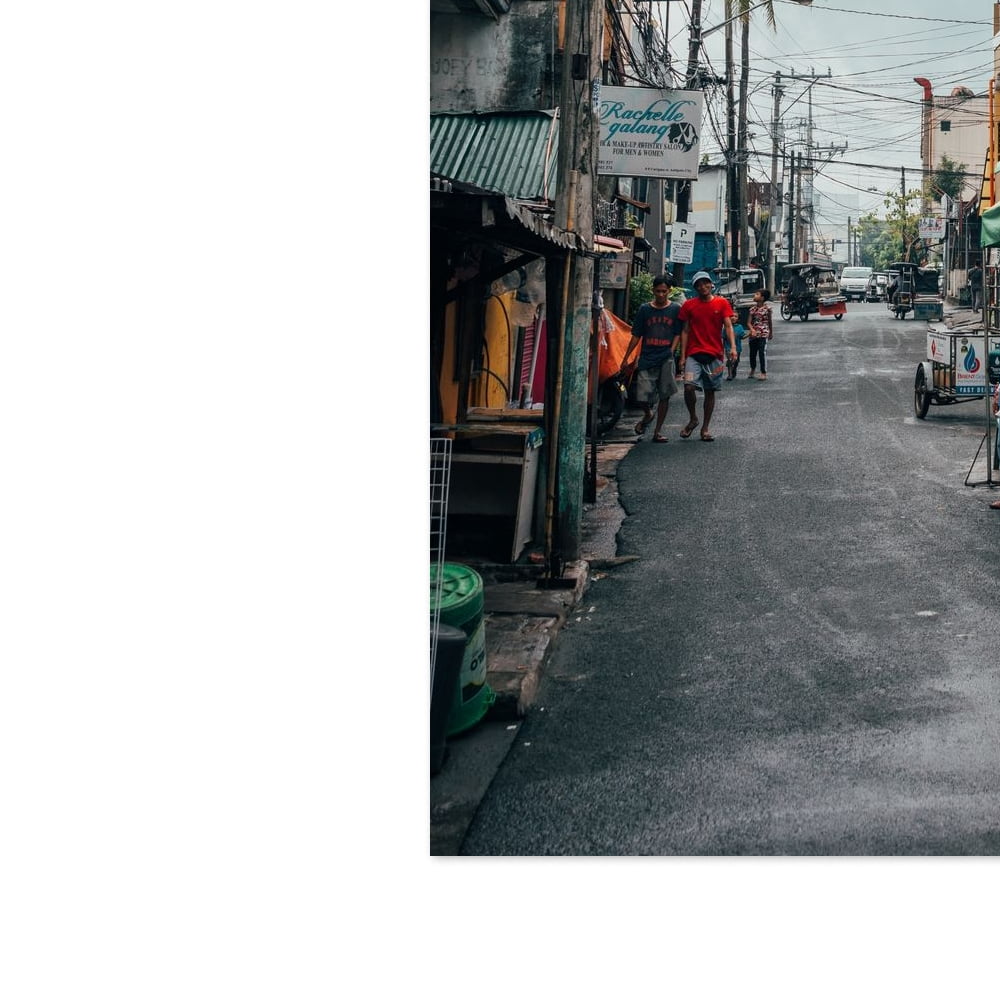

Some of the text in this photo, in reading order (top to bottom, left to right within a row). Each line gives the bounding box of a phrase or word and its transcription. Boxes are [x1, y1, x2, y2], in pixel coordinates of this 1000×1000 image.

[600, 99, 697, 122] Rachelle
[612, 148, 624, 156] FOR
[643, 149, 664, 157] WOMEN
